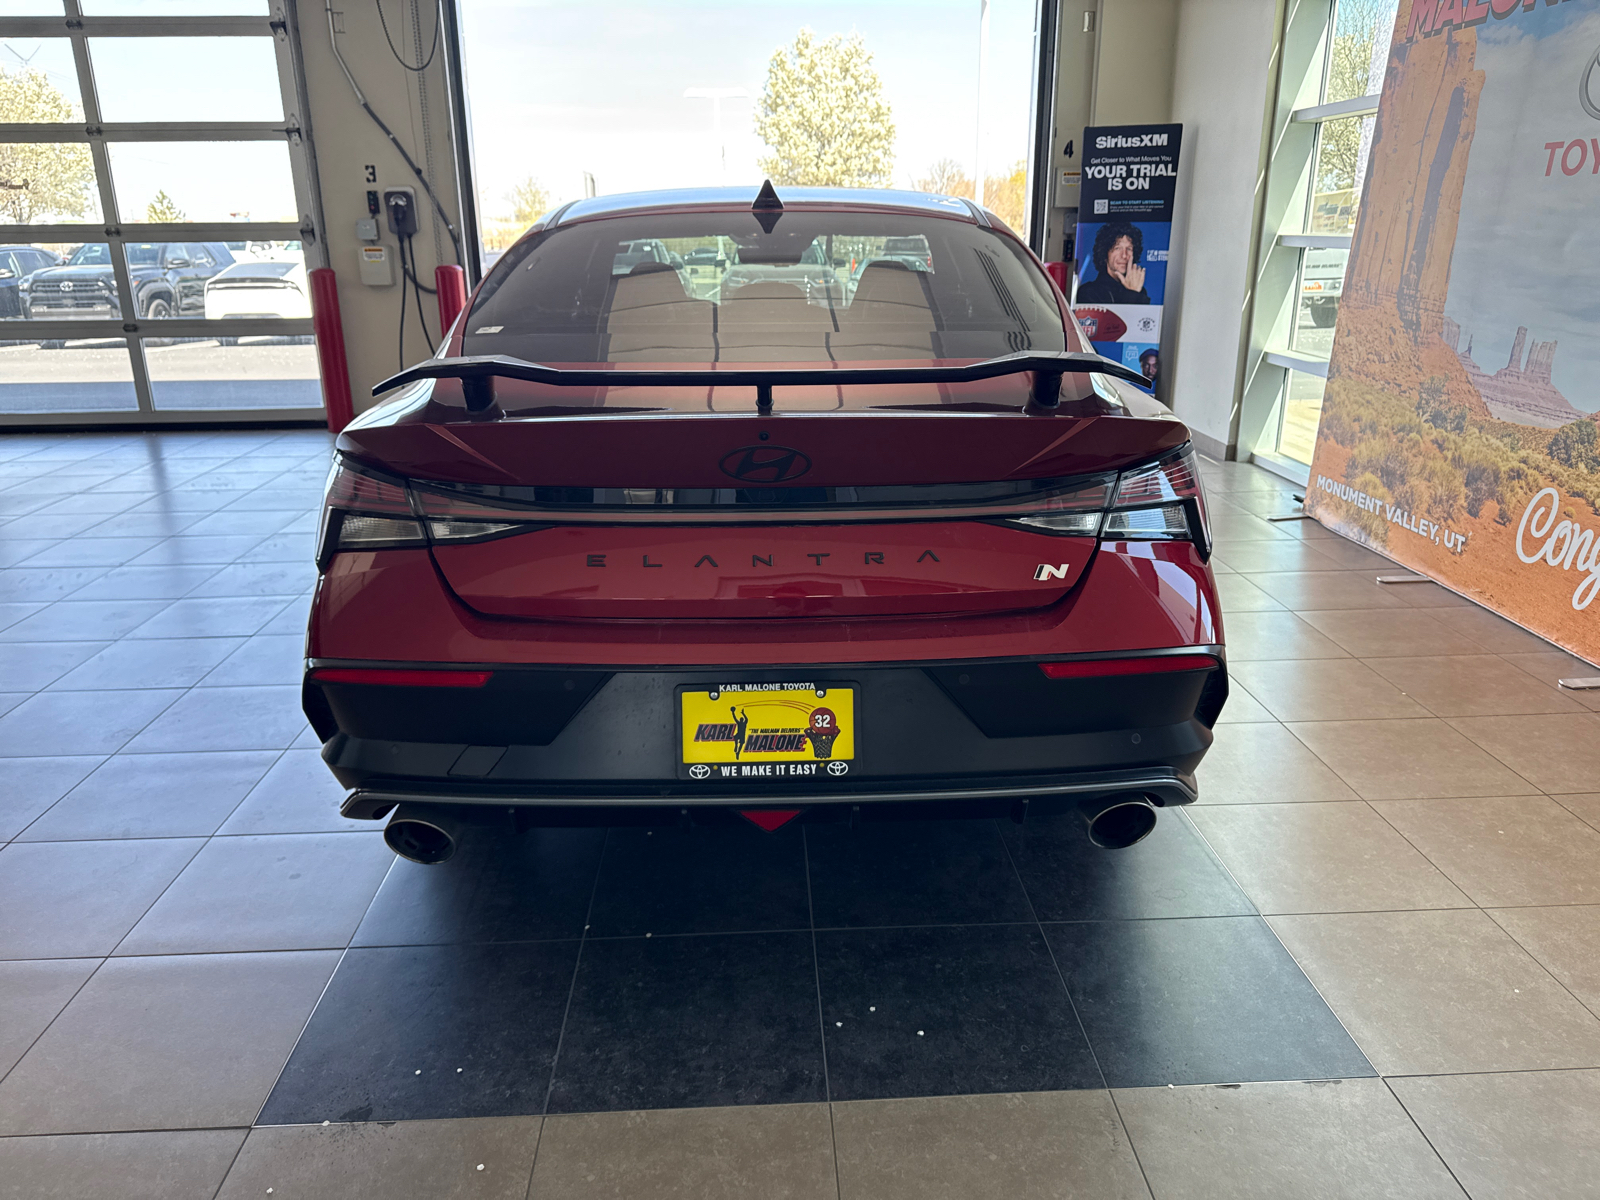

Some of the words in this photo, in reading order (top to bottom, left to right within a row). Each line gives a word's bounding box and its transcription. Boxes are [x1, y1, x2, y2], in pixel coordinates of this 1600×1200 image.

[1063, 139, 1074, 159] 4
[1095, 133, 1169, 149] SiriusXM
[1101, 156, 1118, 164] Closer
[1125, 155, 1140, 163] What
[364, 164, 377, 183] 3
[1084, 165, 1127, 179] YOUR
[1129, 163, 1177, 177] TRIAL
[1107, 177, 1123, 191] IS
[1125, 177, 1150, 190] ON
[1316, 474, 1383, 516] MONUMENT
[1385, 503, 1440, 546] VALLEY,
[1443, 531, 1467, 553] UT
[586, 549, 941, 569] ELANTRA
[719, 684, 743, 693] KARL
[744, 683, 781, 692] MALONE
[783, 682, 816, 690] TOYOTA
[814, 714, 831, 728] 32
[694, 723, 737, 742] KARL
[743, 734, 807, 753] MALONE
[721, 765, 737, 777] WE
[742, 764, 772, 776] MAKE
[776, 764, 785, 776] IT
[789, 763, 817, 775] EASY
